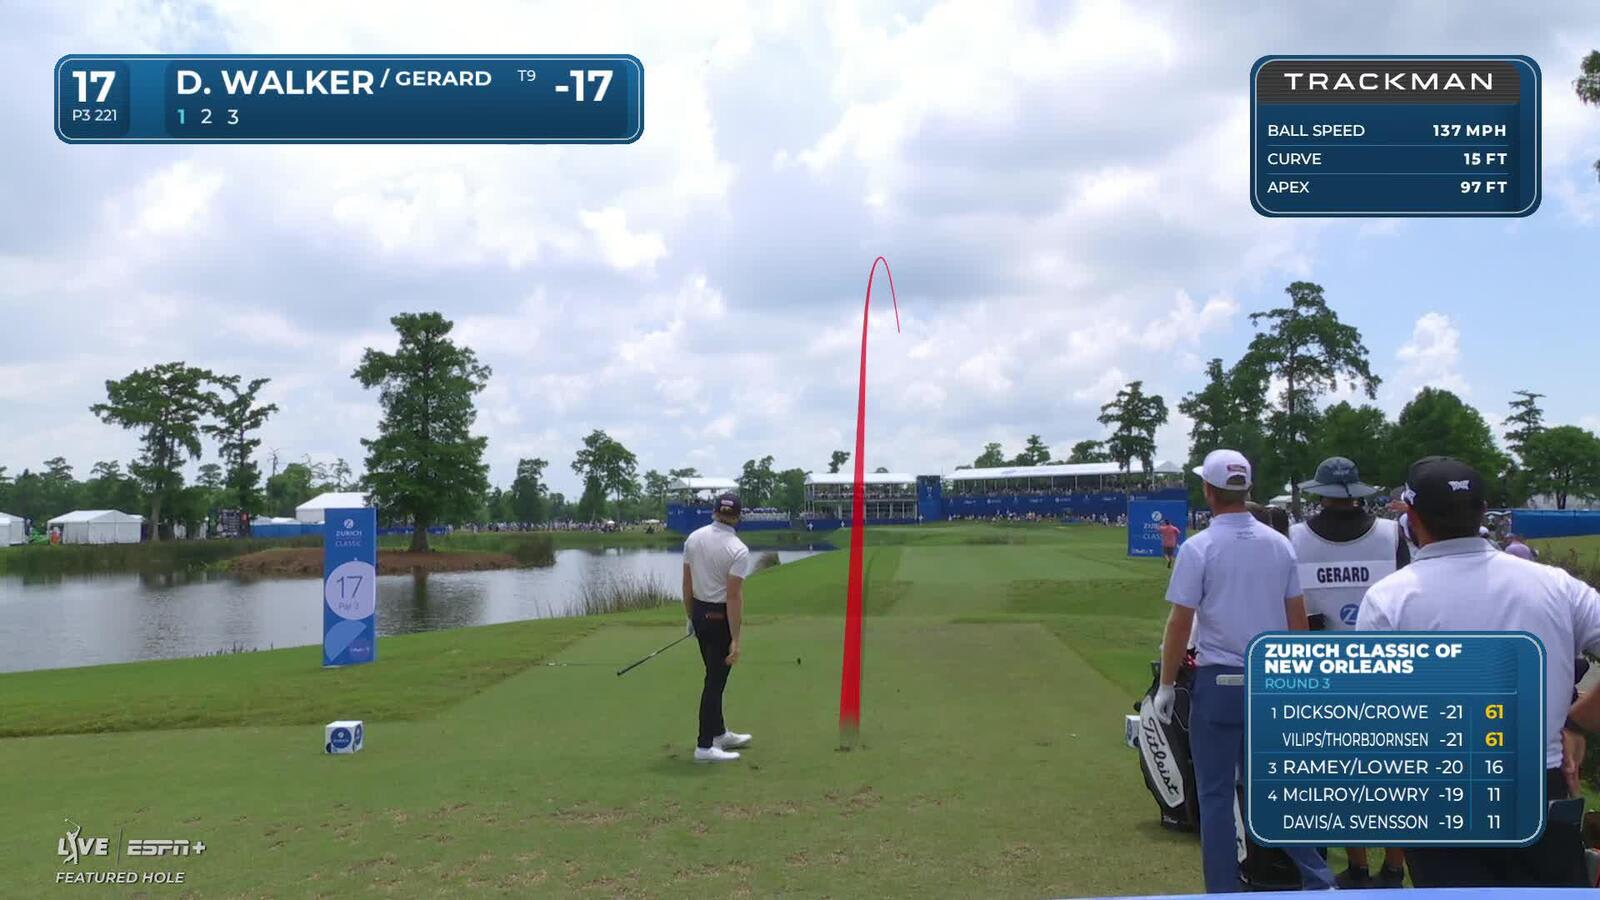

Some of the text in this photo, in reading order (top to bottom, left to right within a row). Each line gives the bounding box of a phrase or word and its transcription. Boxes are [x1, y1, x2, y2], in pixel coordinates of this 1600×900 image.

[1317, 566, 1369, 583] GERARD
[336, 576, 363, 599] 17
[1142, 716, 1180, 795] Titleist
